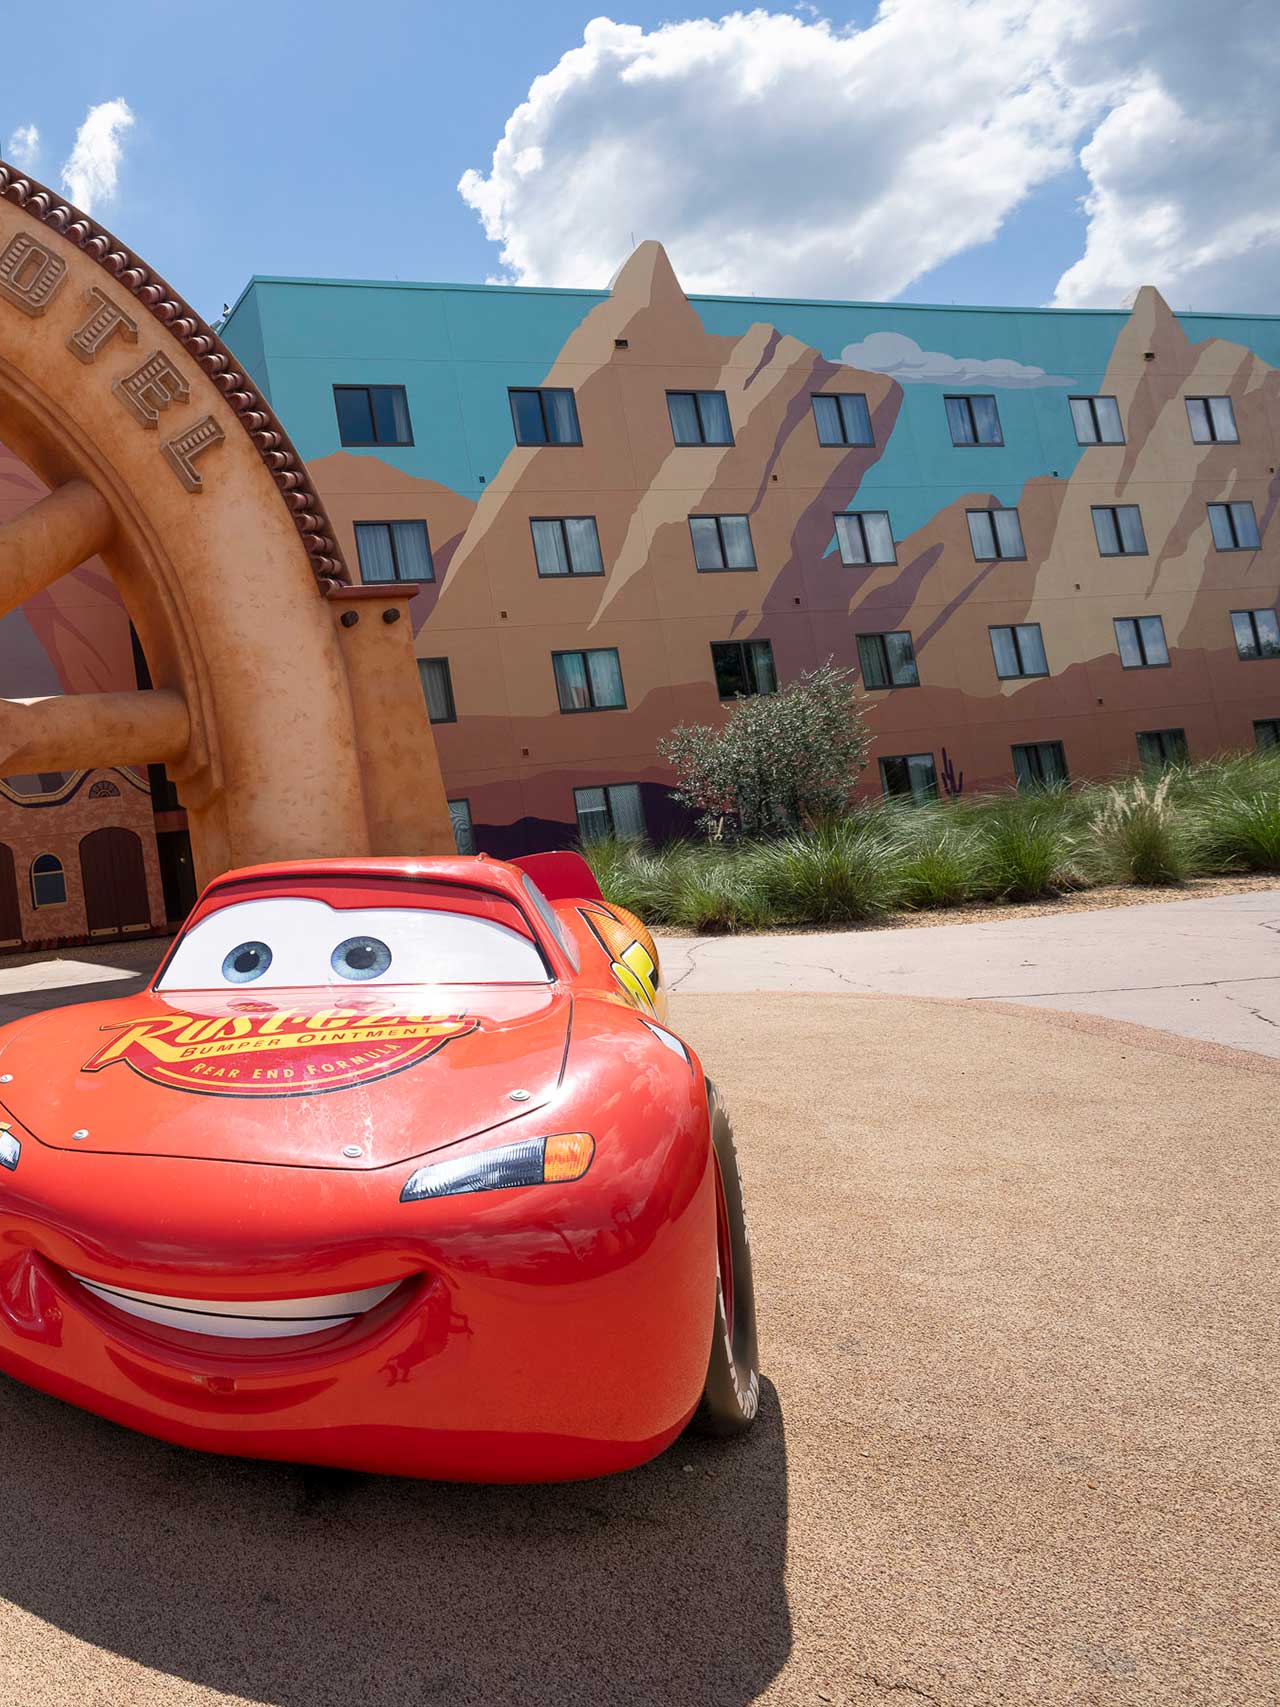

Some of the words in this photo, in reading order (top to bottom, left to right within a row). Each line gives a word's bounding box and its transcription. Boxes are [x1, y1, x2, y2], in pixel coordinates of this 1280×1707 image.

[179, 1039, 281, 1058] BUMPER
[296, 1027, 434, 1044] OINTMENT
[190, 1063, 240, 1079] REAR
[252, 1069, 295, 1080] END
[306, 1042, 401, 1076] FORMULA
